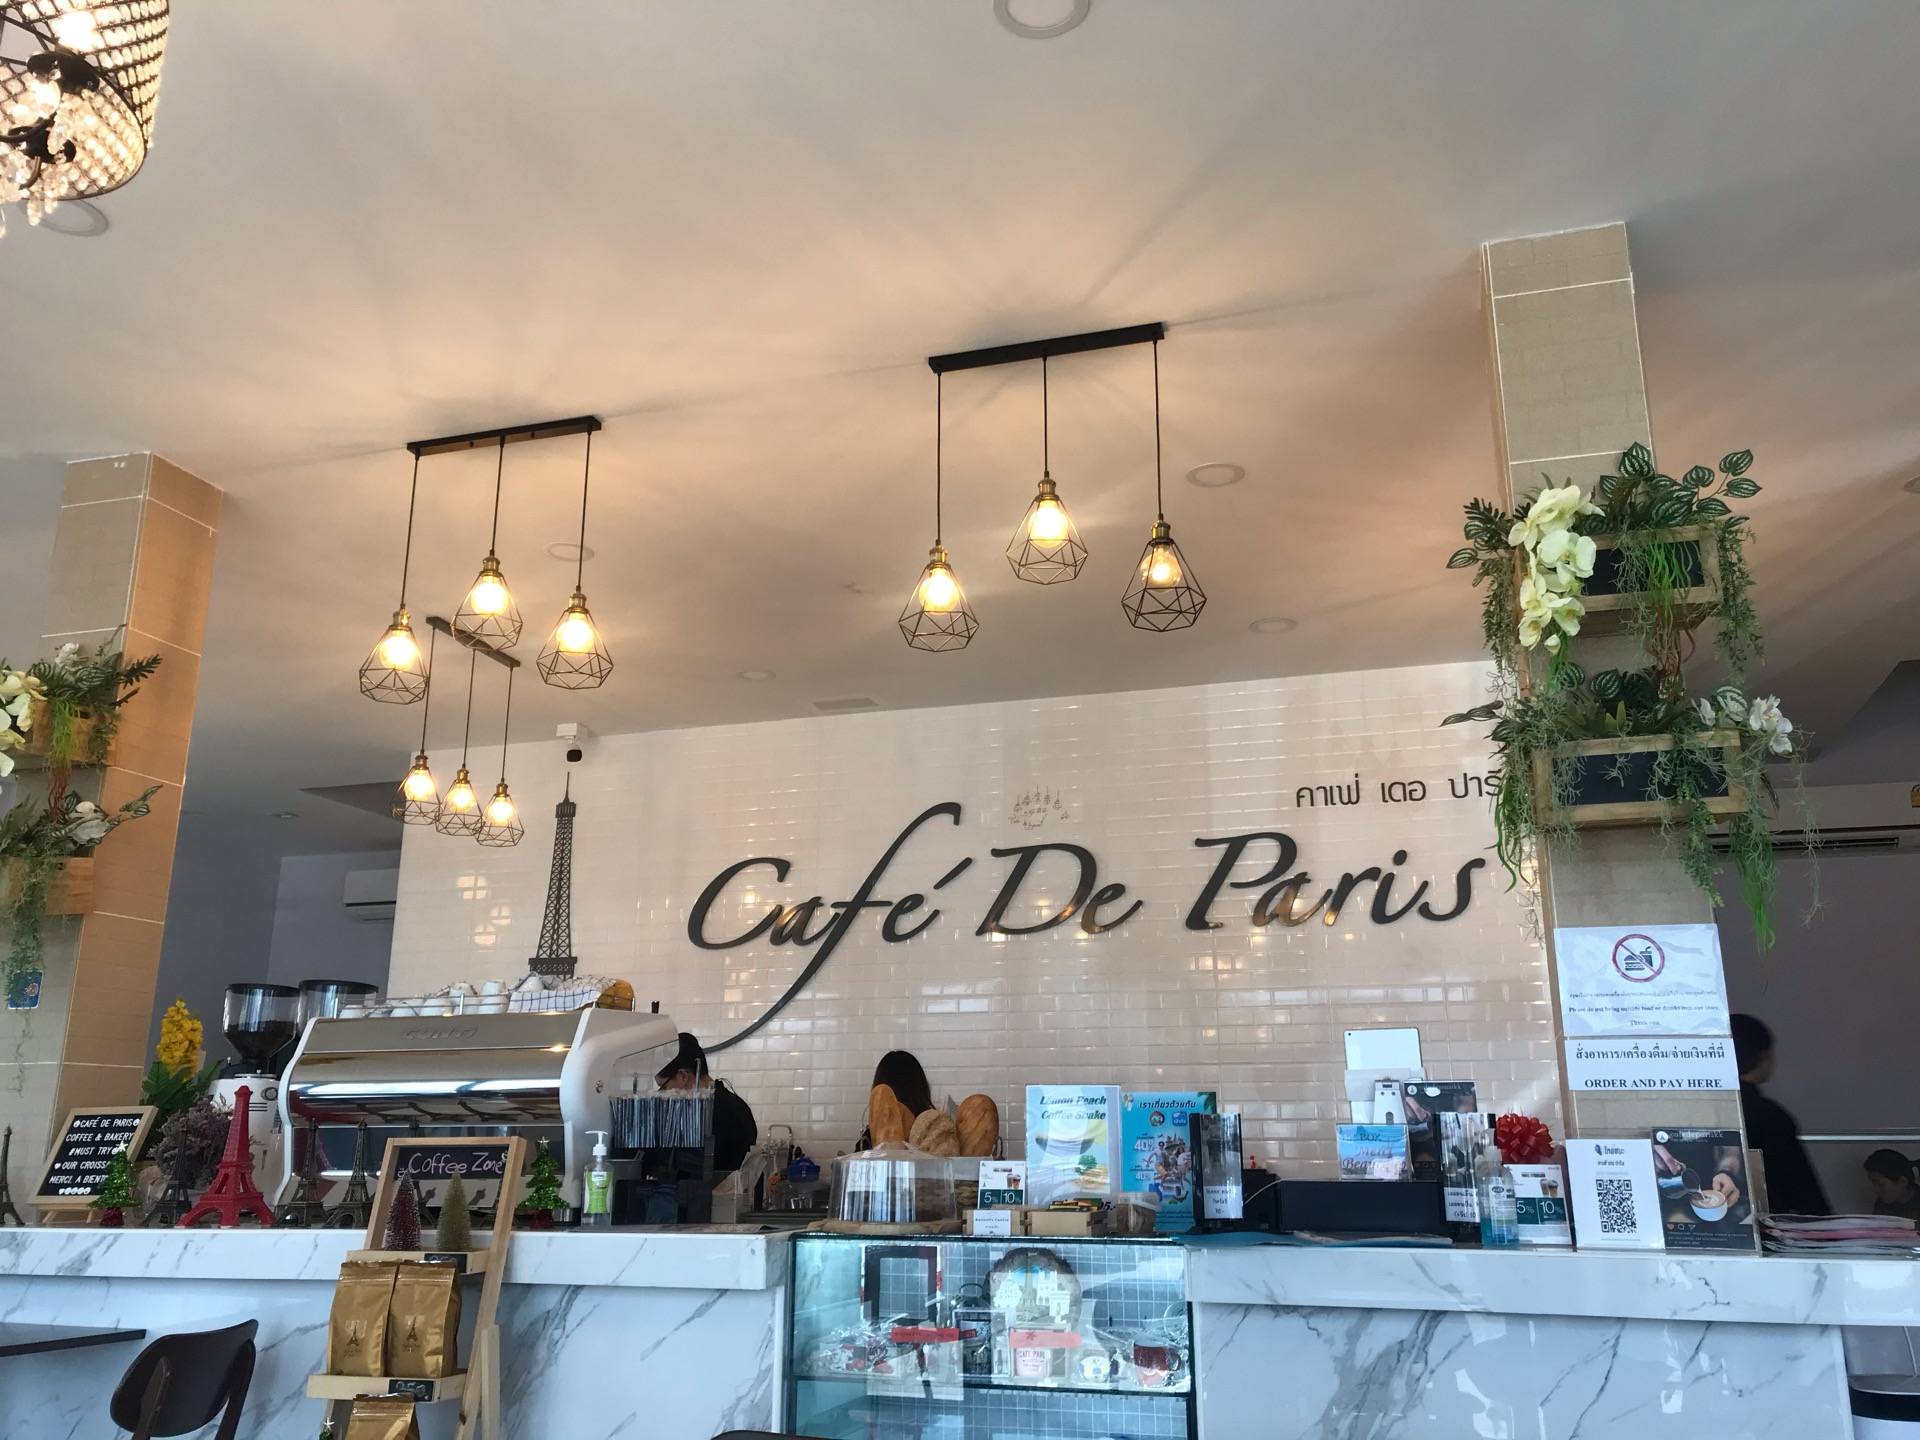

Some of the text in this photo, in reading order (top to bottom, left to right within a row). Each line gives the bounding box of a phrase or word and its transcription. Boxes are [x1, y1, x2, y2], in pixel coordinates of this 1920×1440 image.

[1380, 780, 1426, 803] เดอ
[687, 801, 1486, 1054] Café De Paris
[1584, 1079, 1722, 1088] ORDER AND PAY HERE
[100, 1120, 111, 1128] DE
[113, 1119, 133, 1127] PARIS
[66, 1134, 93, 1142] COFFEE
[104, 1132, 134, 1141] BAKERY
[97, 1147, 113, 1155] TRY
[61, 1161, 110, 1170] OUR CROISS
[408, 1152, 504, 1175] Coffee Zone
